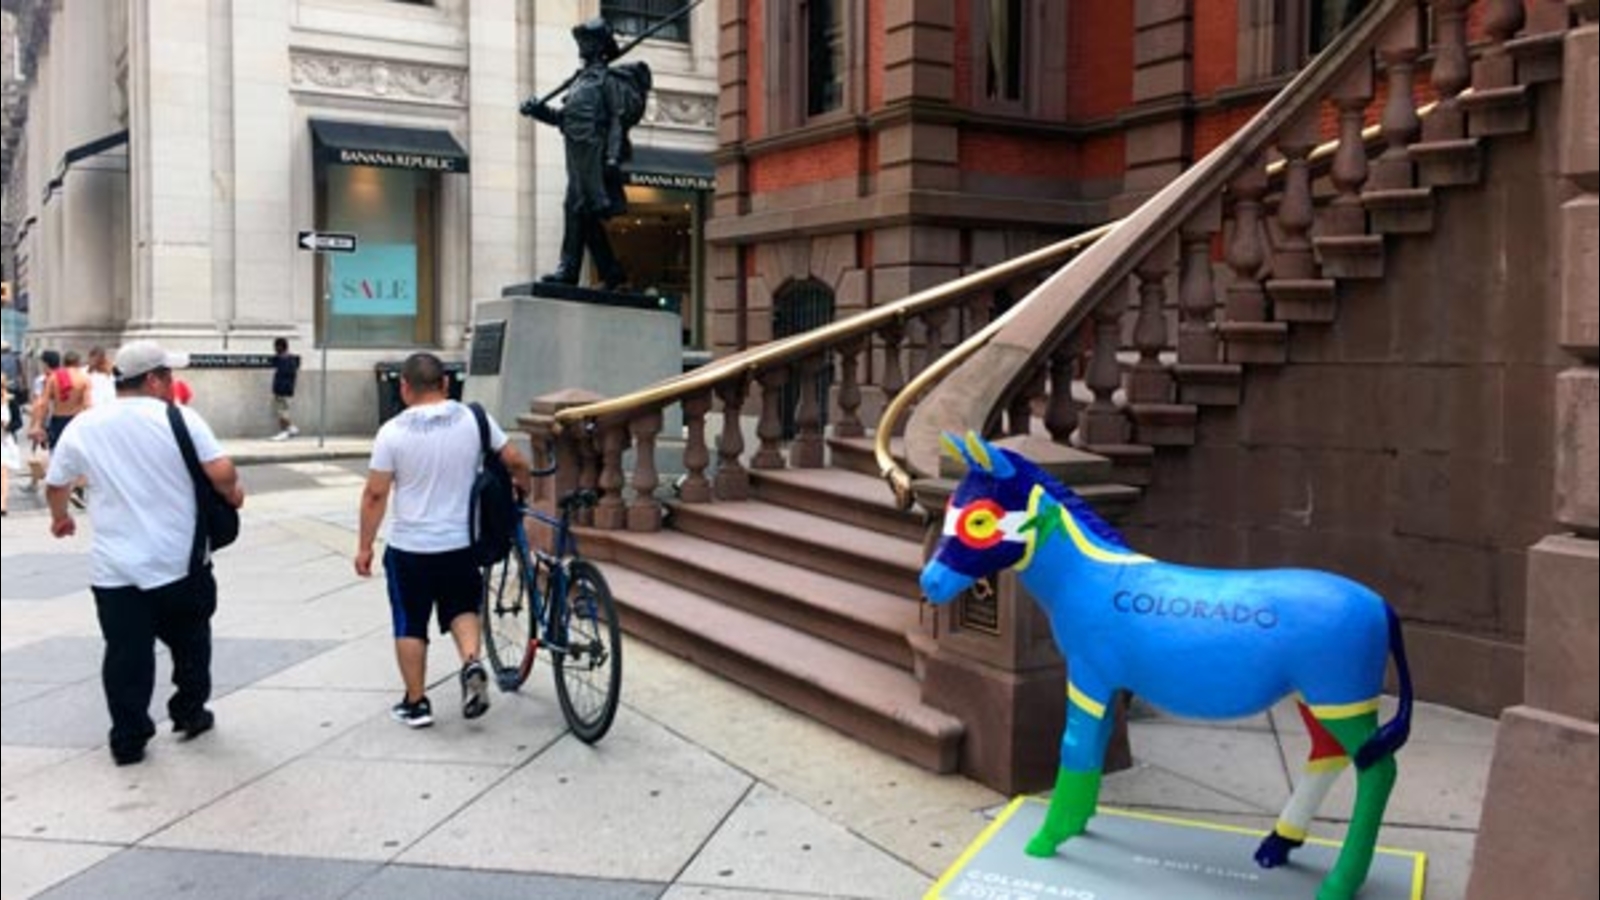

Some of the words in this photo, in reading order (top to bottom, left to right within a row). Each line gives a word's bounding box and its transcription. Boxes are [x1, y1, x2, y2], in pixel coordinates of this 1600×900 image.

[341, 150, 393, 165] BANANA
[396, 154, 455, 170] REPUBLIC
[630, 173, 673, 186] BANANA
[341, 279, 409, 300] SALE
[1112, 590, 1279, 630] COLORADO
[966, 870, 1096, 900] COLORADO
